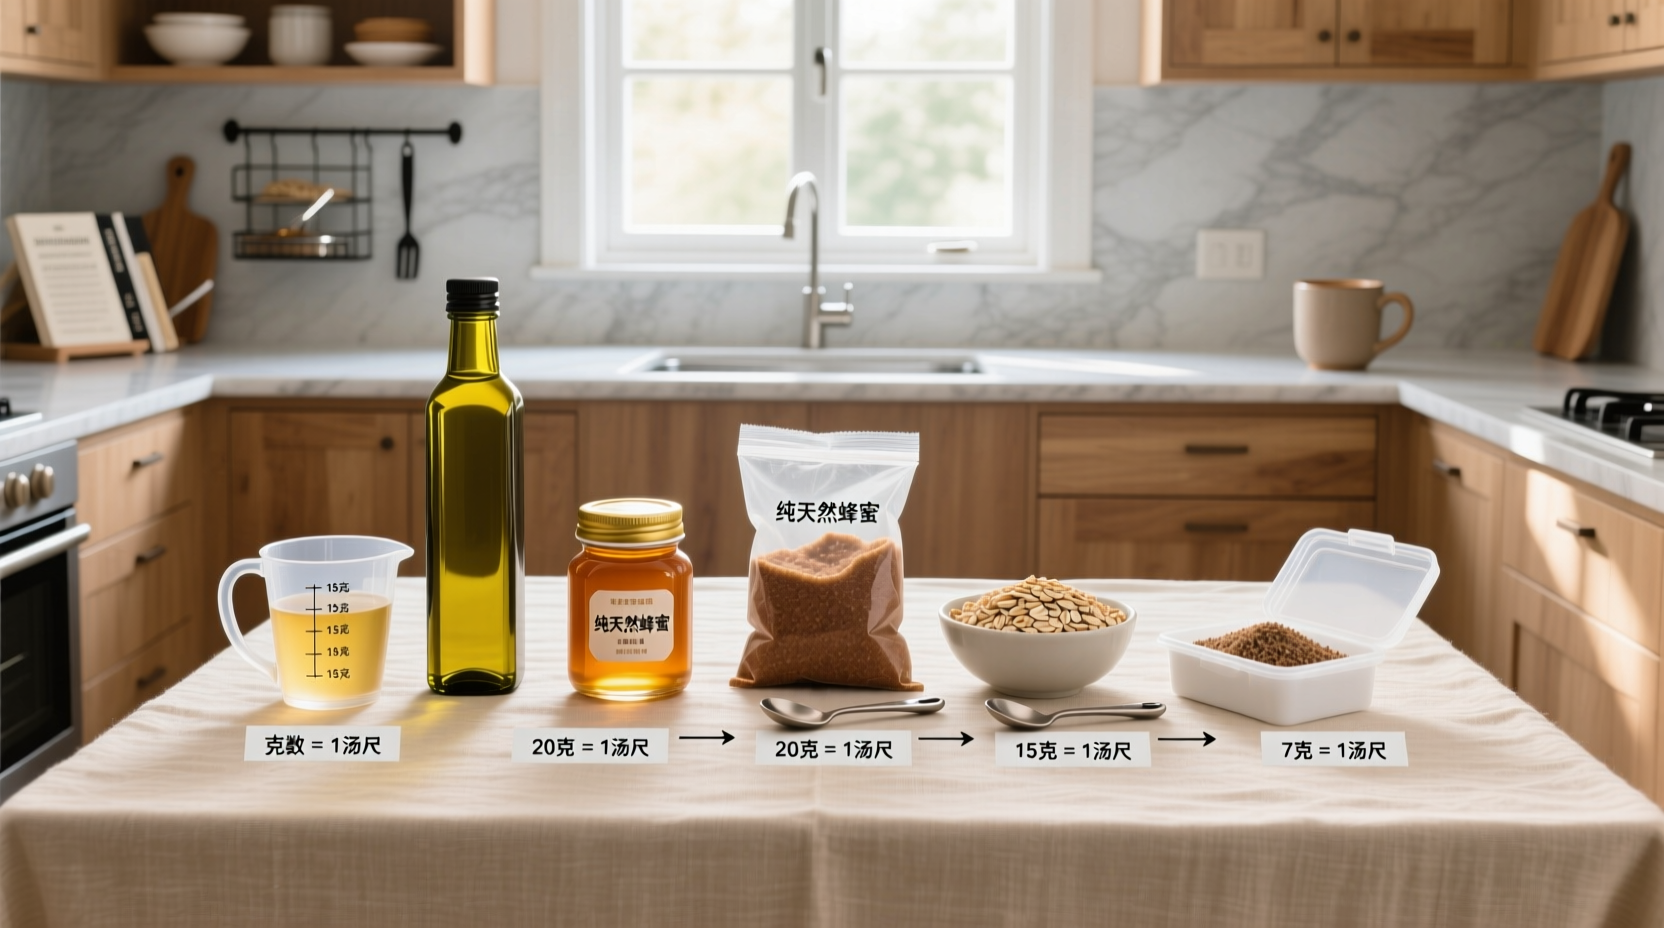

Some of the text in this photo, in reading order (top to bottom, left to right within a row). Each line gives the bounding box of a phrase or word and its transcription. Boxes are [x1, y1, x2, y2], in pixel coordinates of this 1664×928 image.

[776, 500, 880, 524] 纯天然蜂蜜
[311, 741, 324, 749] =
[331, 735, 382, 755] 1汤尺
[532, 737, 650, 757] 20克 = 1汤尺
[775, 739, 893, 760] 20克 = 1汤尺
[1016, 740, 1132, 761] 15克 = 1汤尺
[1281, 740, 1388, 761] 7克 = 1汤尺
